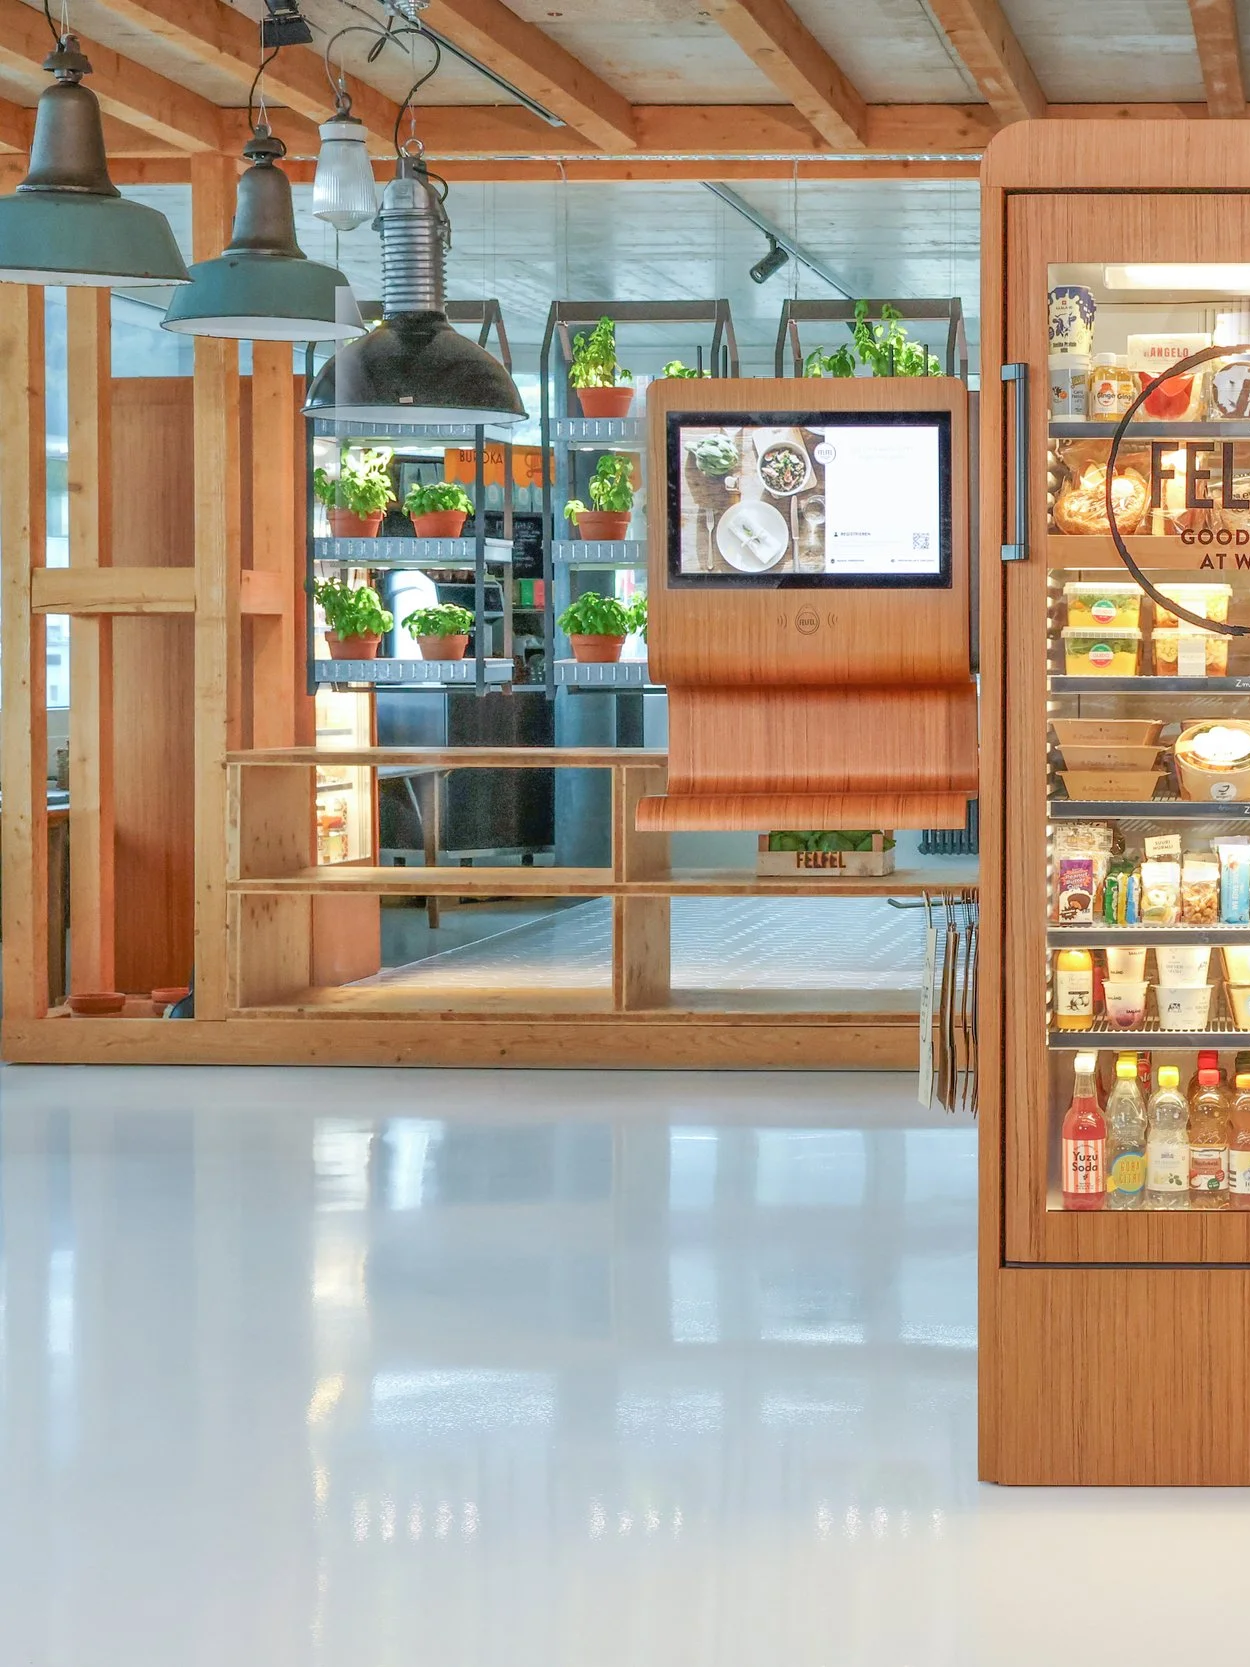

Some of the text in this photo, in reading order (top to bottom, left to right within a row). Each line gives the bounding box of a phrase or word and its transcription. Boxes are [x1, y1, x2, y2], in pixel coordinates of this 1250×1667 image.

[1150, 347, 1189, 358] ANGELO
[1181, 528, 1250, 546] GOOD
[1200, 553, 1227, 570] AT
[796, 851, 846, 869] FELFEL
[1073, 1151, 1098, 1161] Yuzu
[1072, 1162, 1098, 1172] Soda
